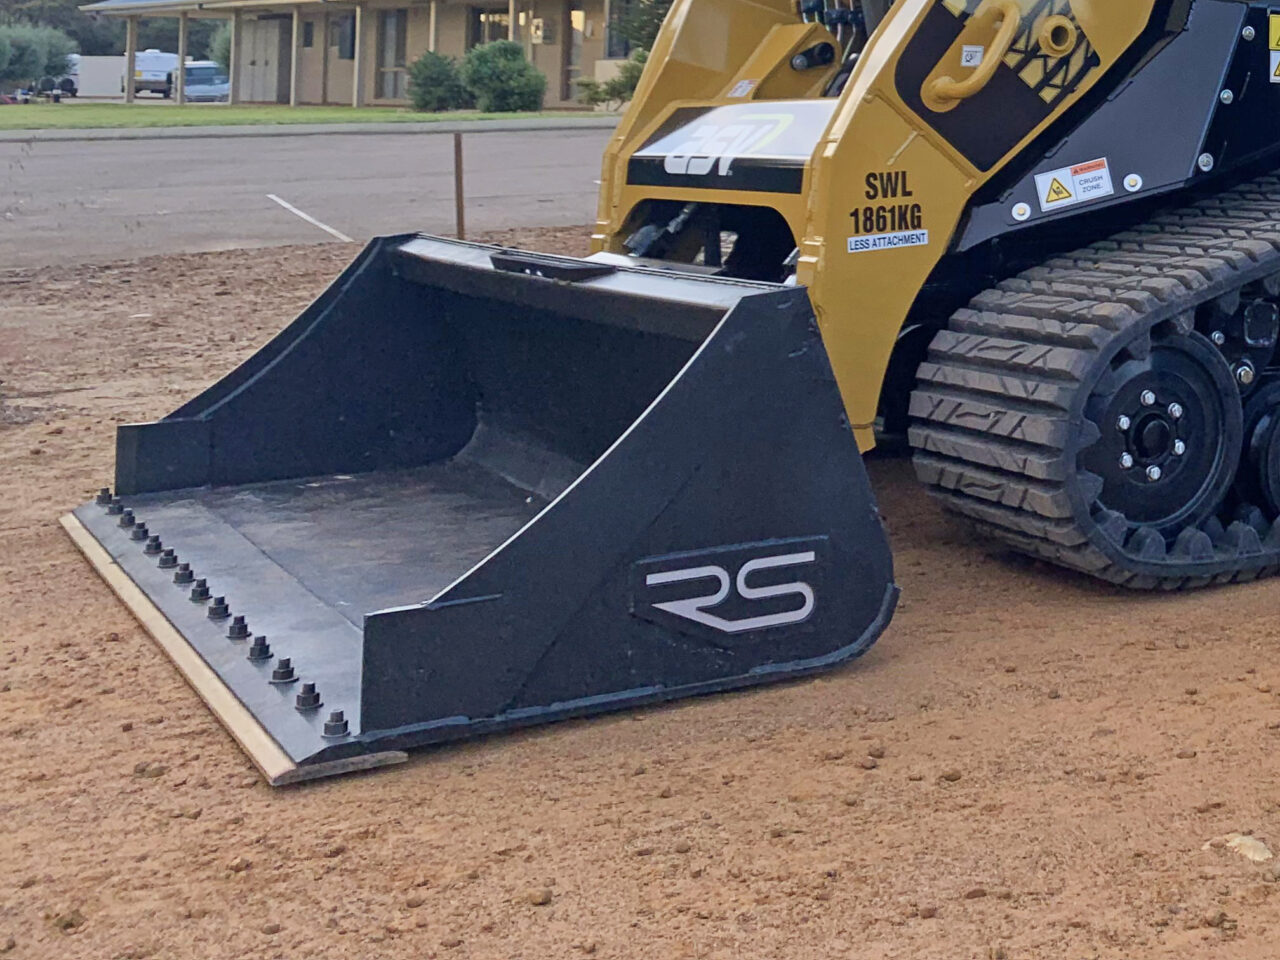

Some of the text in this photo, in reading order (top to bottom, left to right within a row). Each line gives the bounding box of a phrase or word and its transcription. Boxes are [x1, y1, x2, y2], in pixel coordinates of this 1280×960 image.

[864, 170, 913, 200] SWL
[1078, 175, 1104, 186] CRUSH
[849, 203, 922, 235] 1861KG
[849, 232, 926, 251] LESS ATTACHMENT
